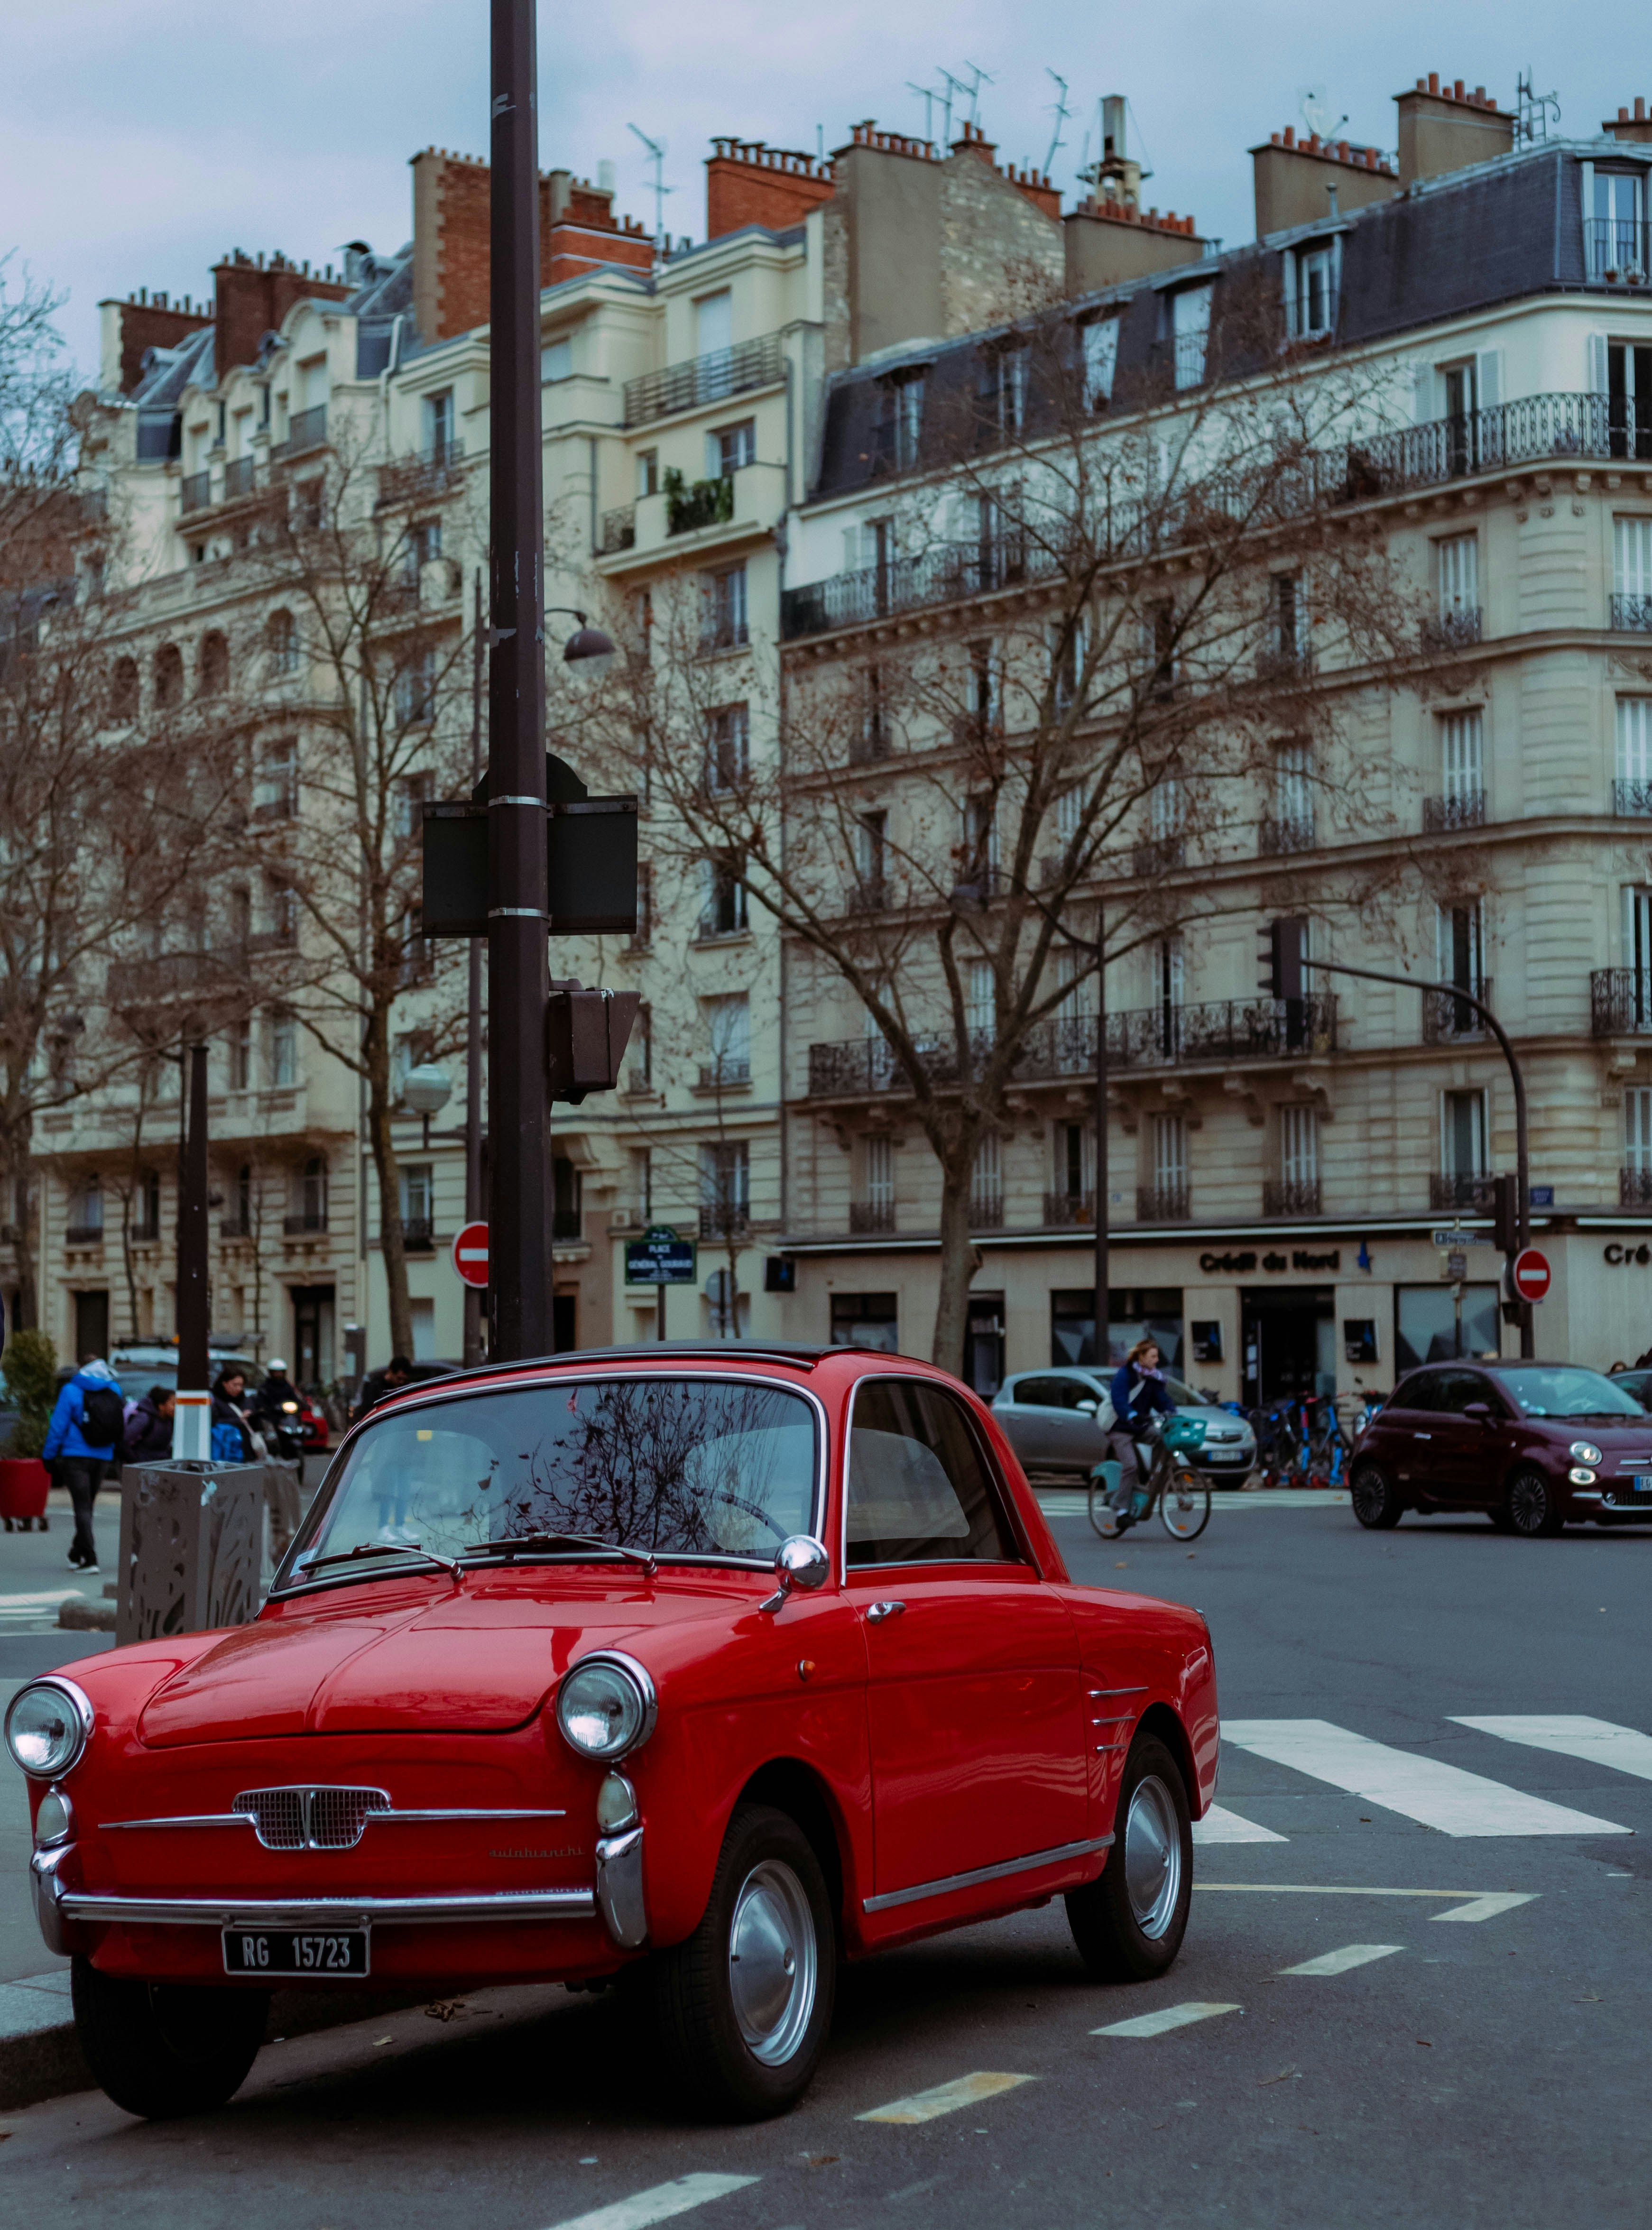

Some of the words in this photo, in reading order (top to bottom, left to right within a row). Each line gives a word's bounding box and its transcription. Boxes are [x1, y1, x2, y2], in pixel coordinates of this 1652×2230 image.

[1200, 1253, 1256, 1271] Crédit
[1263, 1253, 1286, 1270] du
[1293, 1250, 1339, 1269] Nord
[241, 1936, 269, 1967] RG
[292, 1937, 350, 1968] 15723
